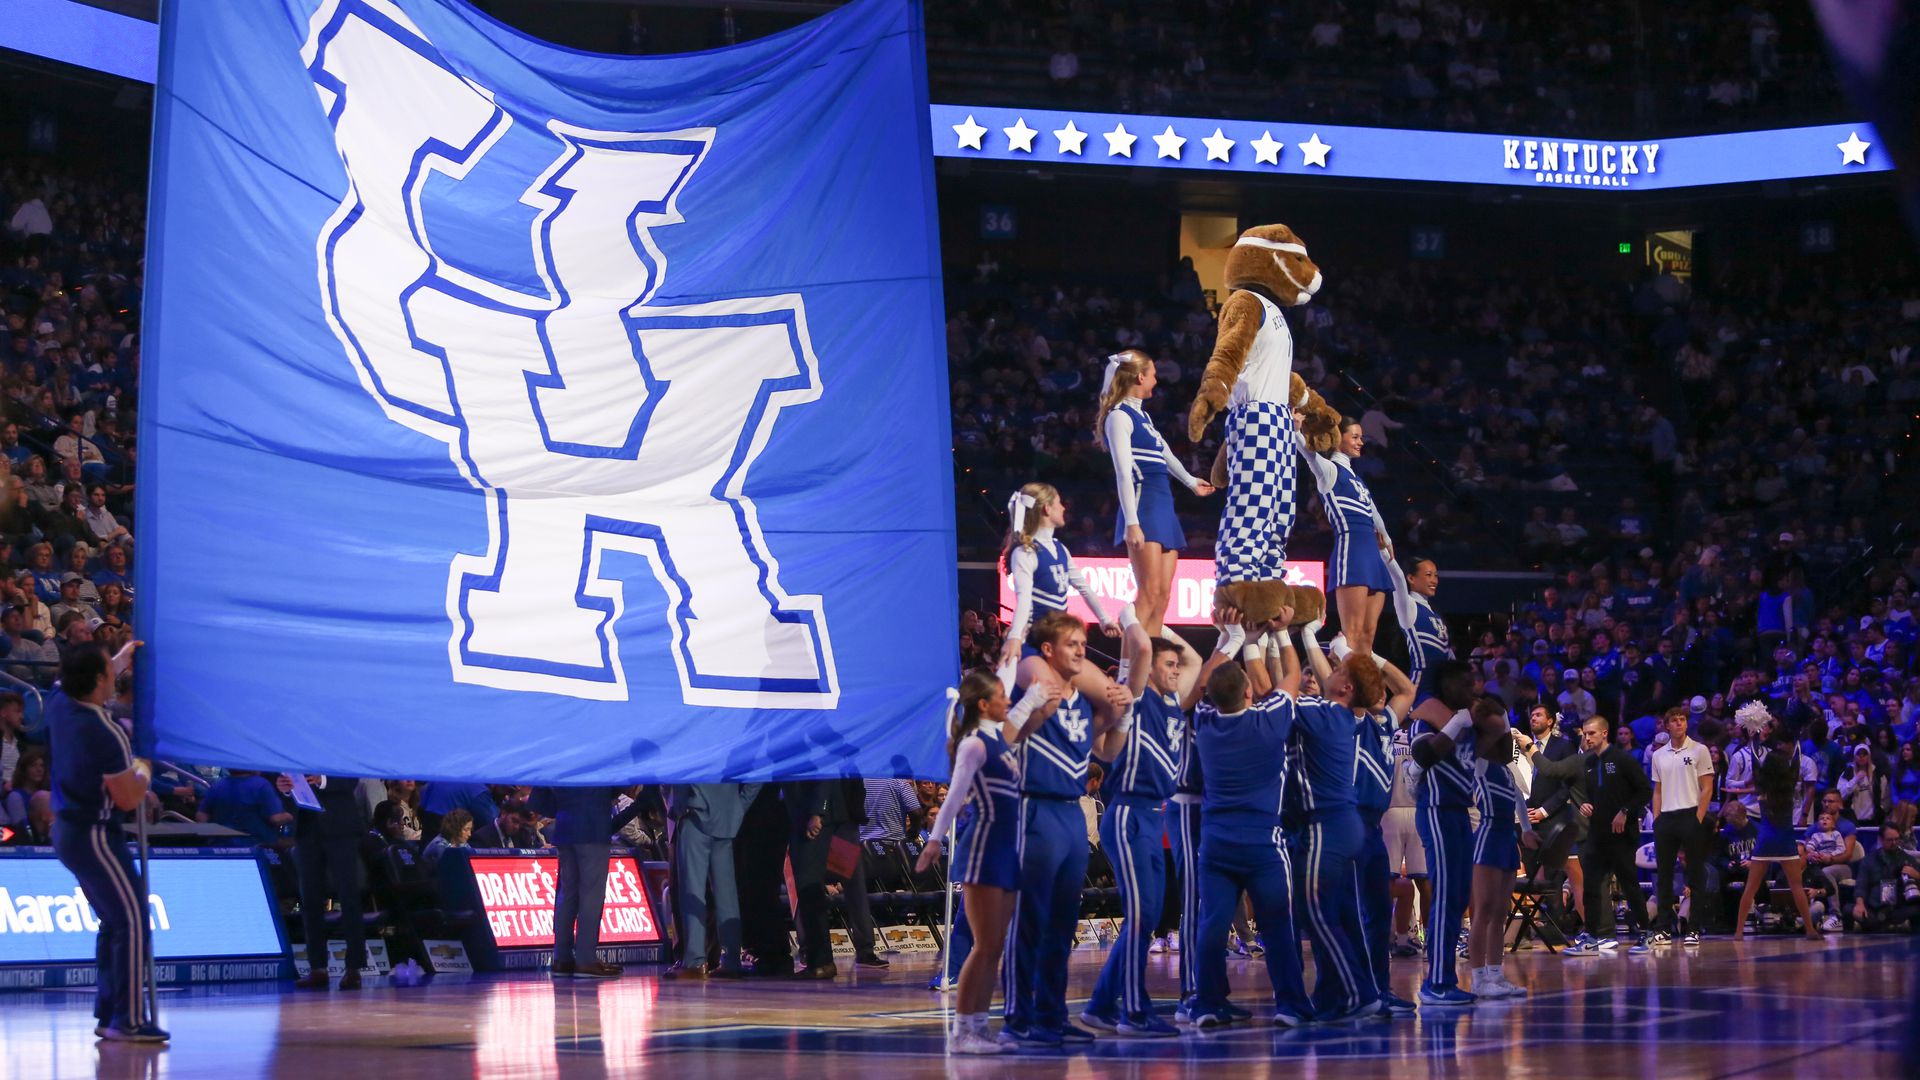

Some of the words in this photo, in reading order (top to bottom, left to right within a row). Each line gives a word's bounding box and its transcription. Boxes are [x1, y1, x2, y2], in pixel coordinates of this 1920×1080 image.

[1503, 139, 1659, 174] KENTUCKY
[1536, 172, 1629, 186] BASKETBALL
[985, 212, 1012, 231] 36
[1415, 232, 1440, 251] 37
[1805, 227, 1831, 246] 38
[1057, 708, 1089, 742] UK
[1683, 756, 1693, 766] UK
[0, 886, 170, 934] Maratn
[487, 909, 522, 938] GIFT
[605, 906, 652, 934] CARDS
[607, 948, 617, 963] ON
[618, 947, 659, 962] COMMITMENT
[191, 964, 207, 981] BIG
[208, 964, 221, 980] ON
[222, 962, 280, 980] COMMITMENT
[433, 961, 470, 969] CHEVROLET
